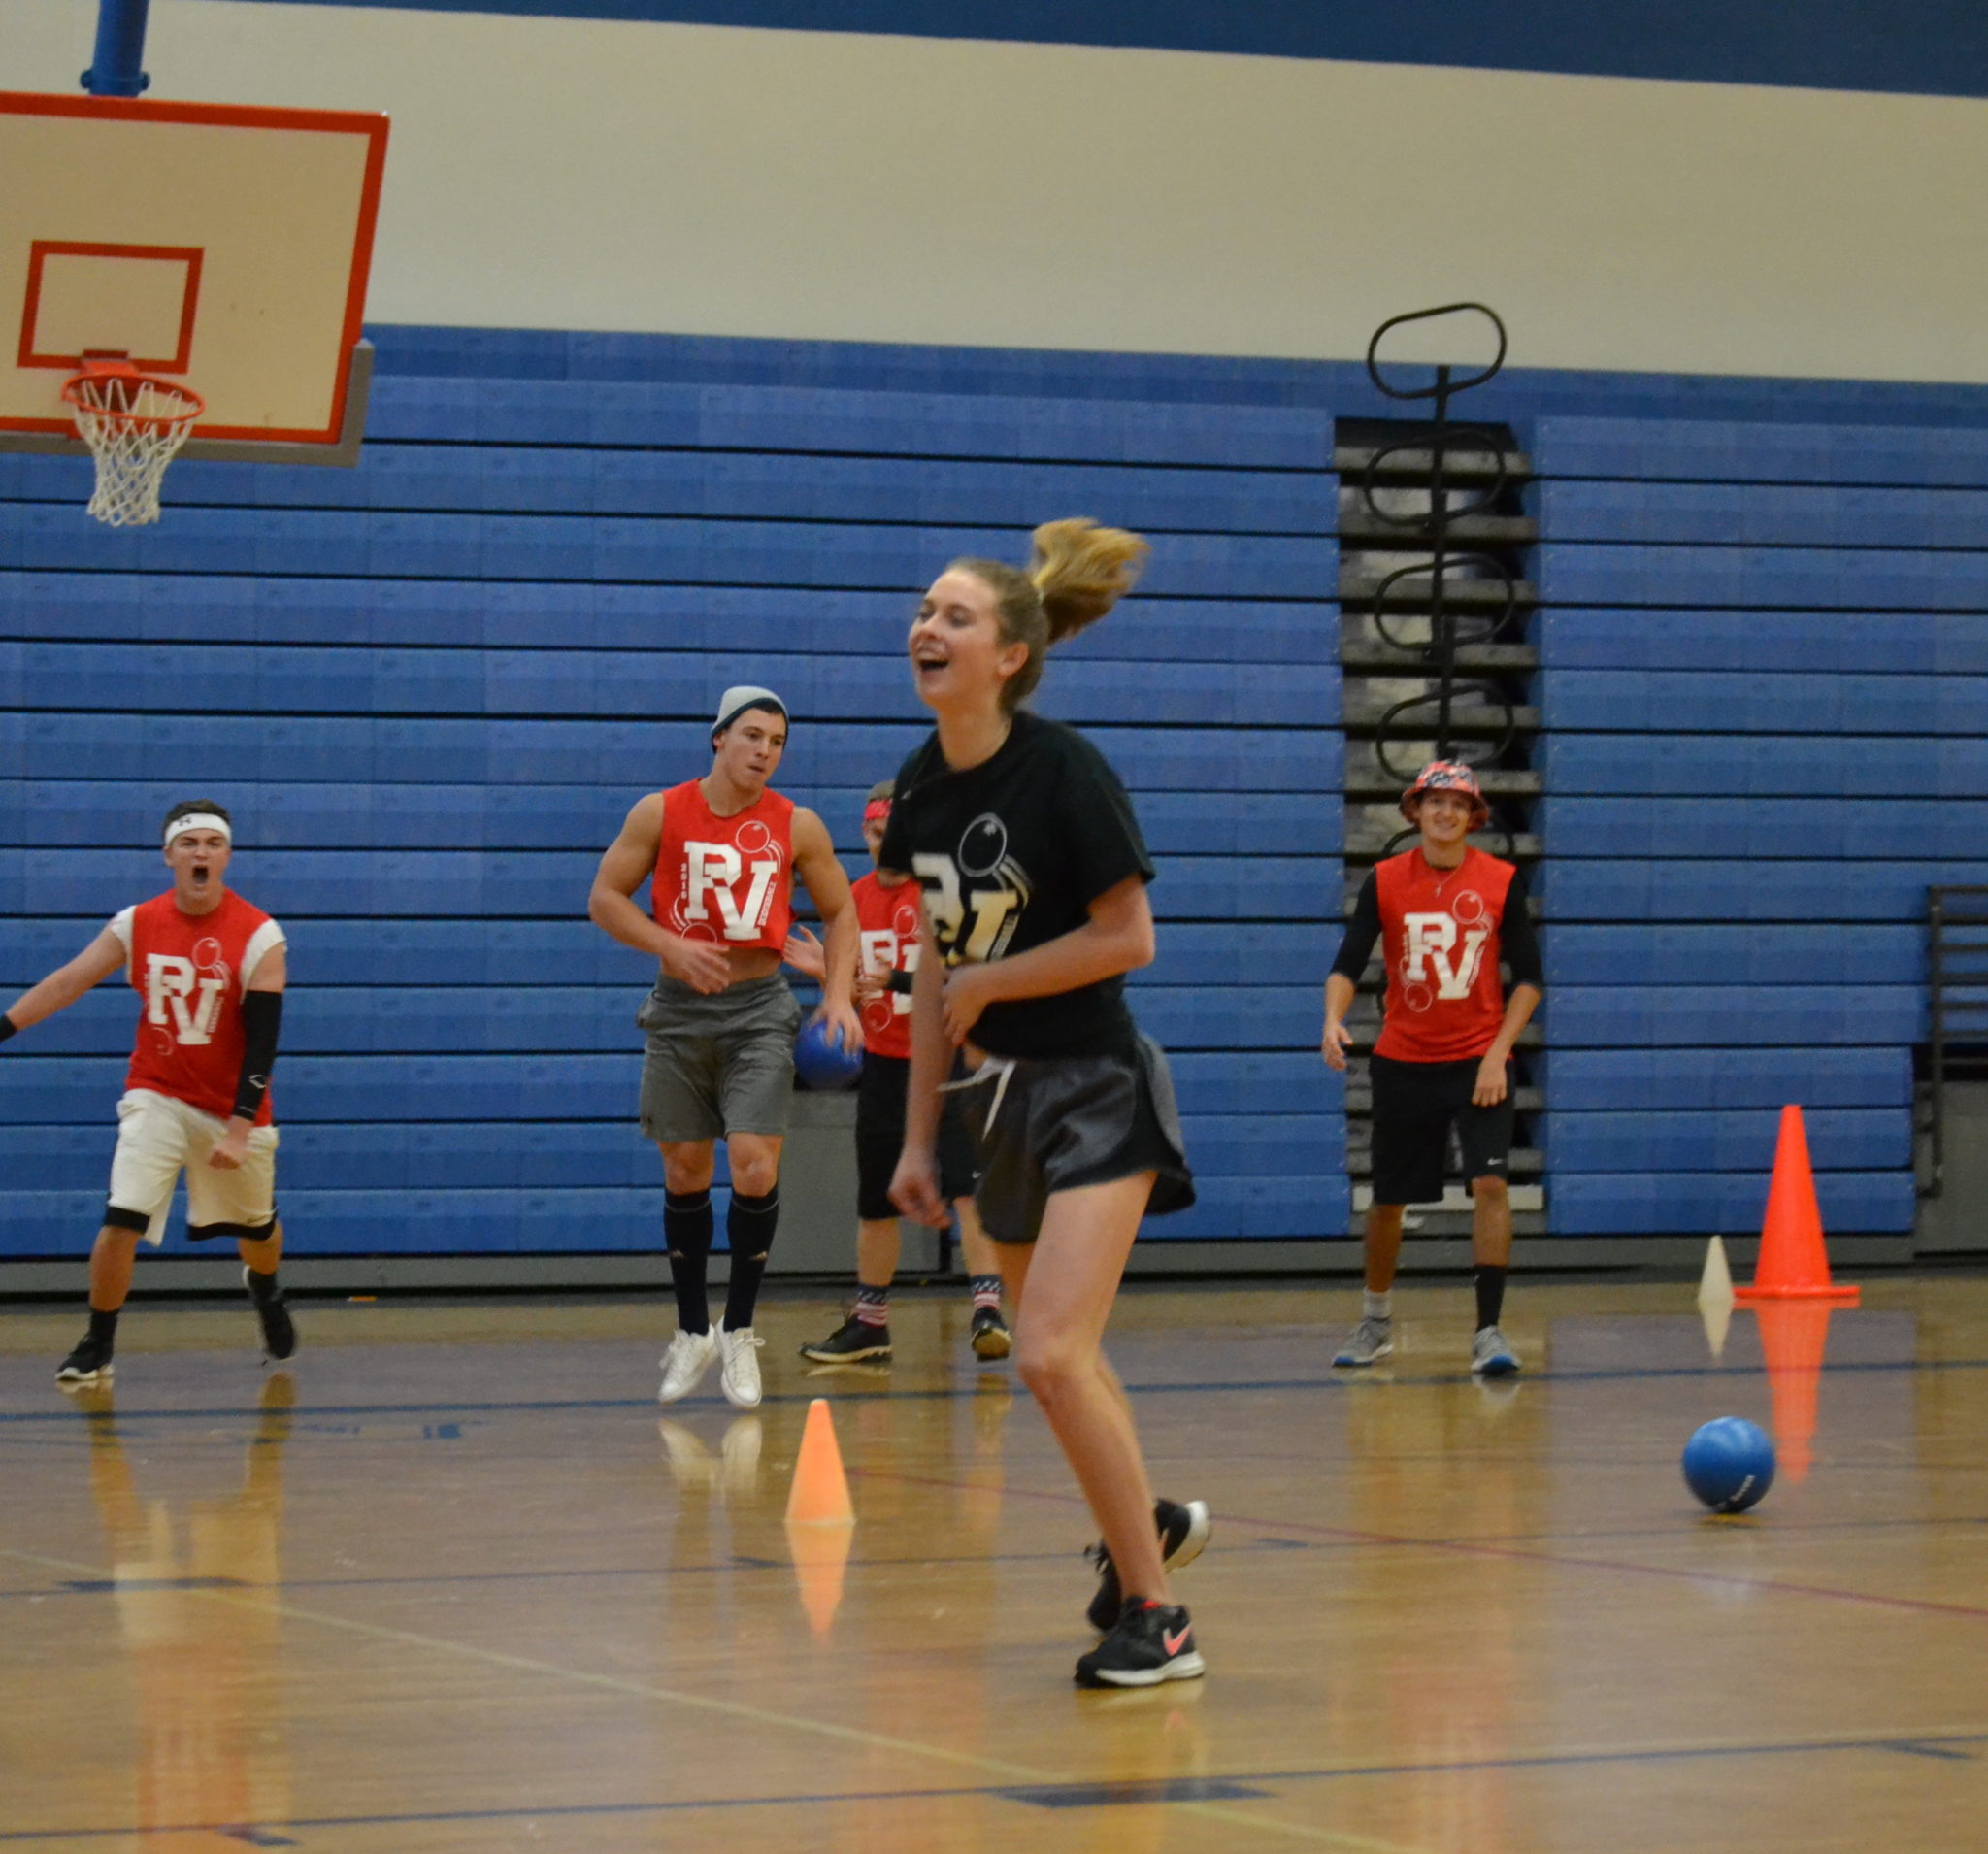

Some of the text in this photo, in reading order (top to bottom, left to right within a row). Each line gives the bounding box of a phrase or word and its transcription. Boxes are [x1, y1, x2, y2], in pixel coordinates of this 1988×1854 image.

[684, 841, 777, 940] RV
[147, 953, 224, 1044] RV
[1404, 912, 1488, 1000] RV
